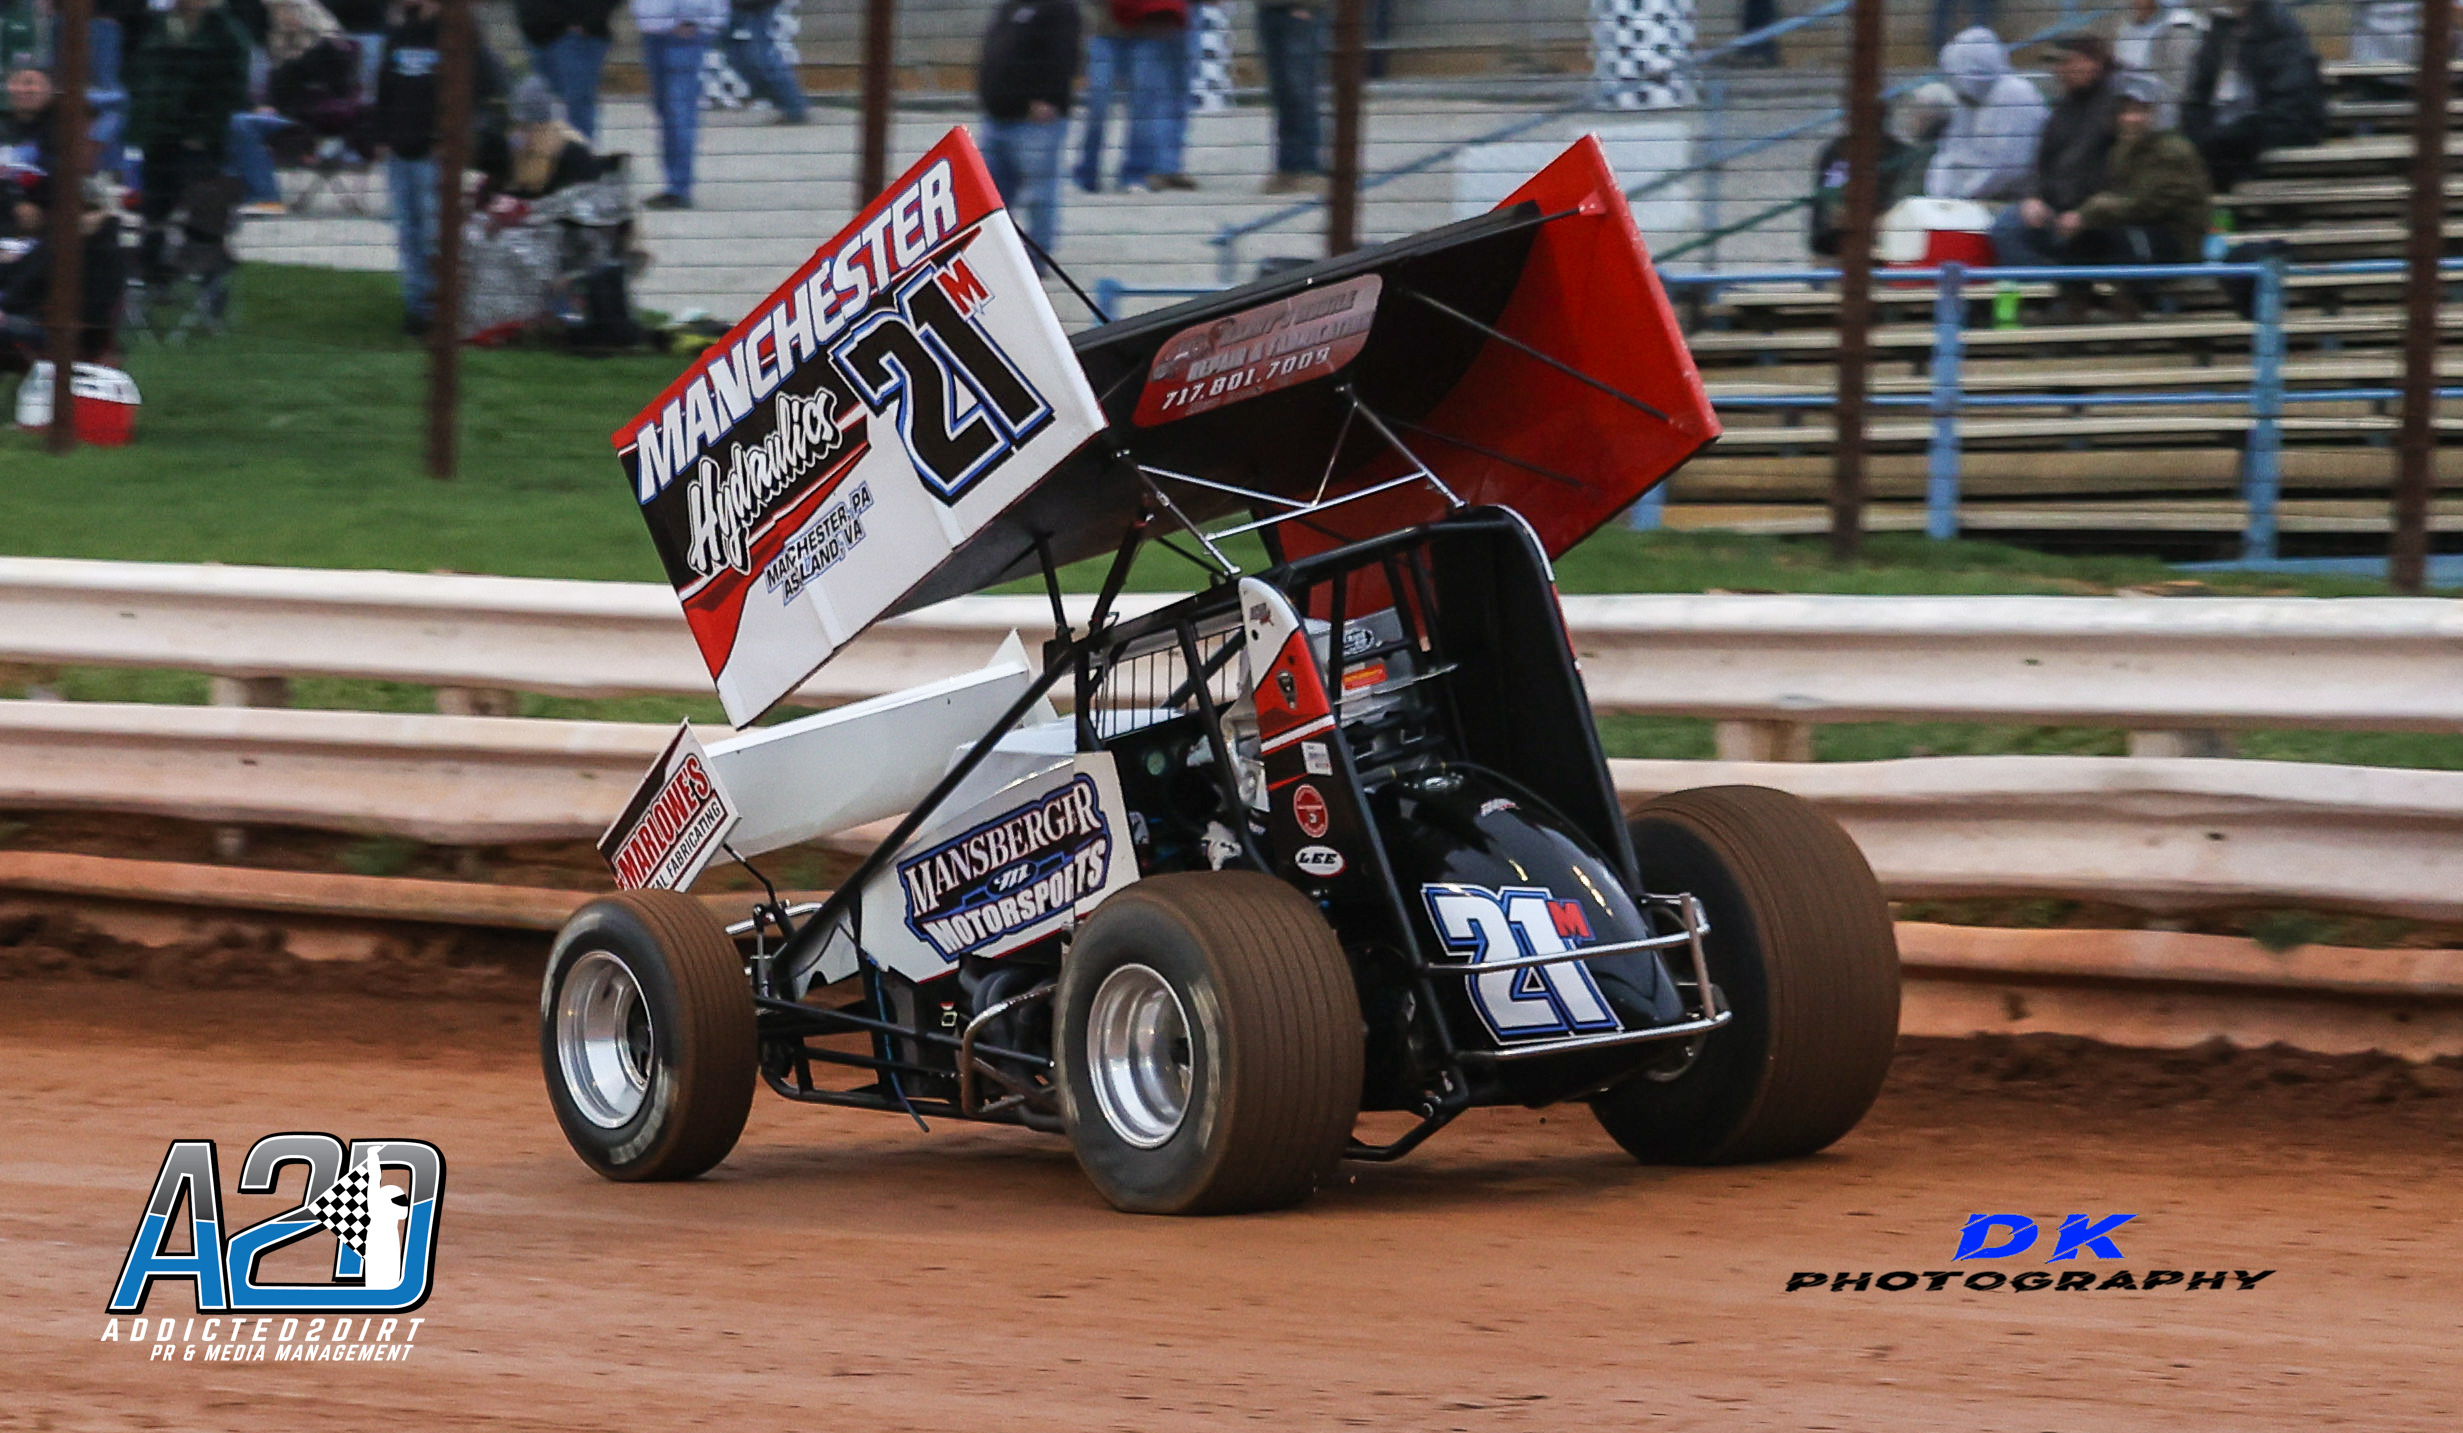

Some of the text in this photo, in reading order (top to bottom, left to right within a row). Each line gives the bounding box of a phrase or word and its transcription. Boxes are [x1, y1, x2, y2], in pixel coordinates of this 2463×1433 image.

[636, 158, 959, 504] MANCHESTER
[1161, 346, 1330, 411] 717.801.7009
[687, 386, 842, 576] Hydaulics
[852, 487, 870, 513] PA
[785, 520, 862, 599] ASLAND, VA
[616, 755, 710, 889] MARLOWE'S
[666, 801, 722, 878] FABRICATING
[1299, 852, 1338, 865] LEE
